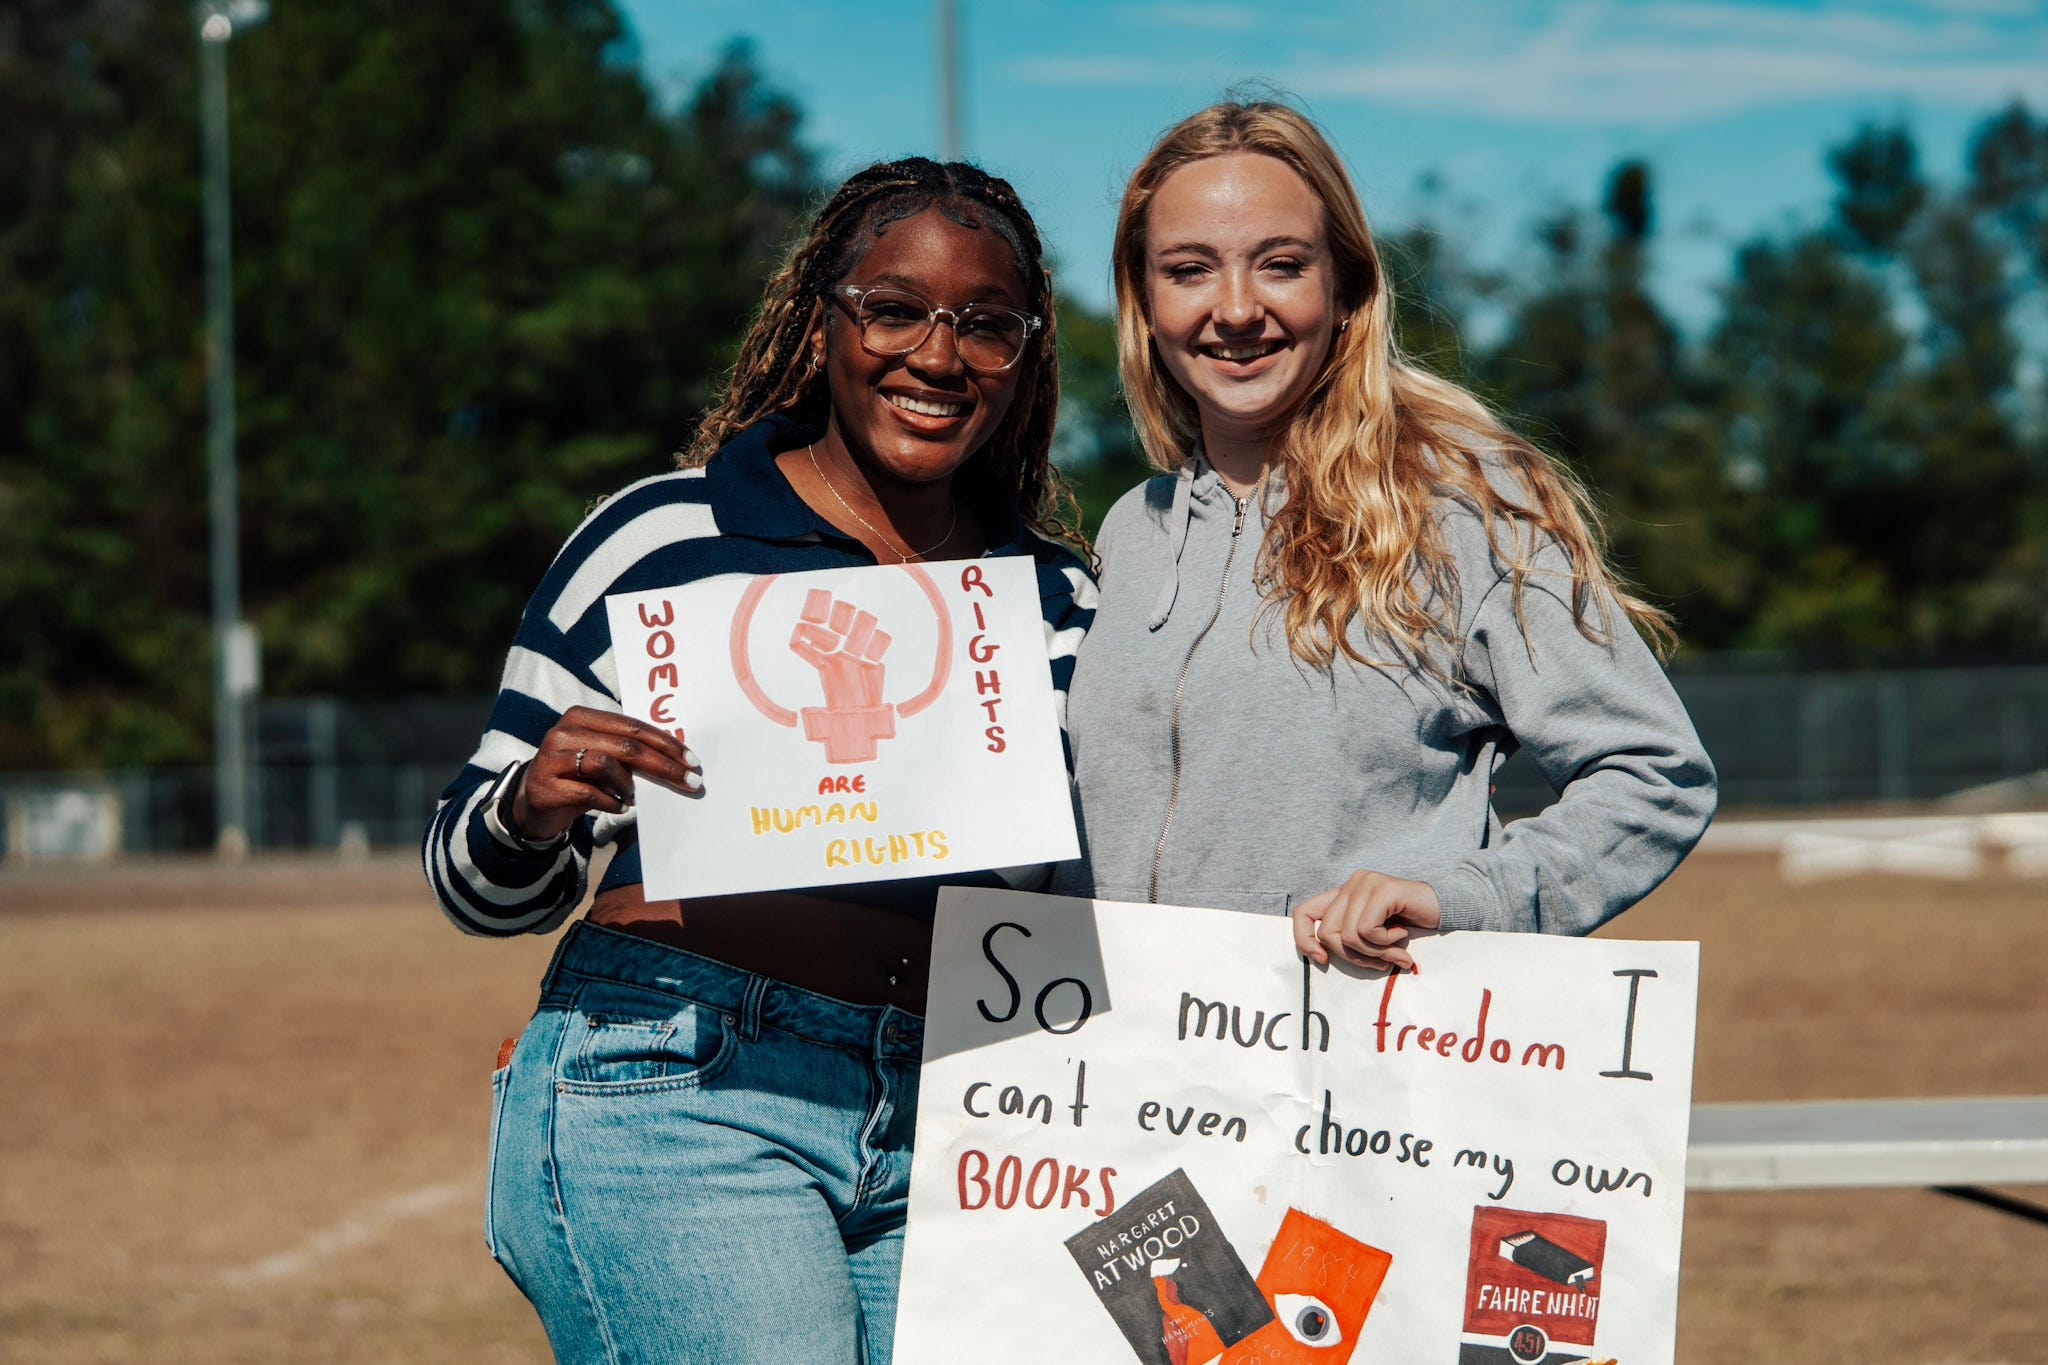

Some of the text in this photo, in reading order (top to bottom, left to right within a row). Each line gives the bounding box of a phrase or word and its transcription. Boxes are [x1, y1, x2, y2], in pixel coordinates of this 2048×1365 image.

[961, 565, 1007, 754] RIGHTS
[818, 774, 867, 795] ARE
[750, 801, 879, 835] HUMAN
[825, 830, 951, 868] RIGHTS
[976, 922, 1658, 1081] So much freedom I
[963, 1056, 1653, 1200] can't even choose my own
[957, 1149, 1118, 1217] BOOKS
[1093, 1215, 1200, 1291] ATWOOD
[1282, 1240, 1361, 1296] 1984
[1477, 1284, 1600, 1320] FAHRENHEIT
[1513, 1330, 1542, 1355] 451
